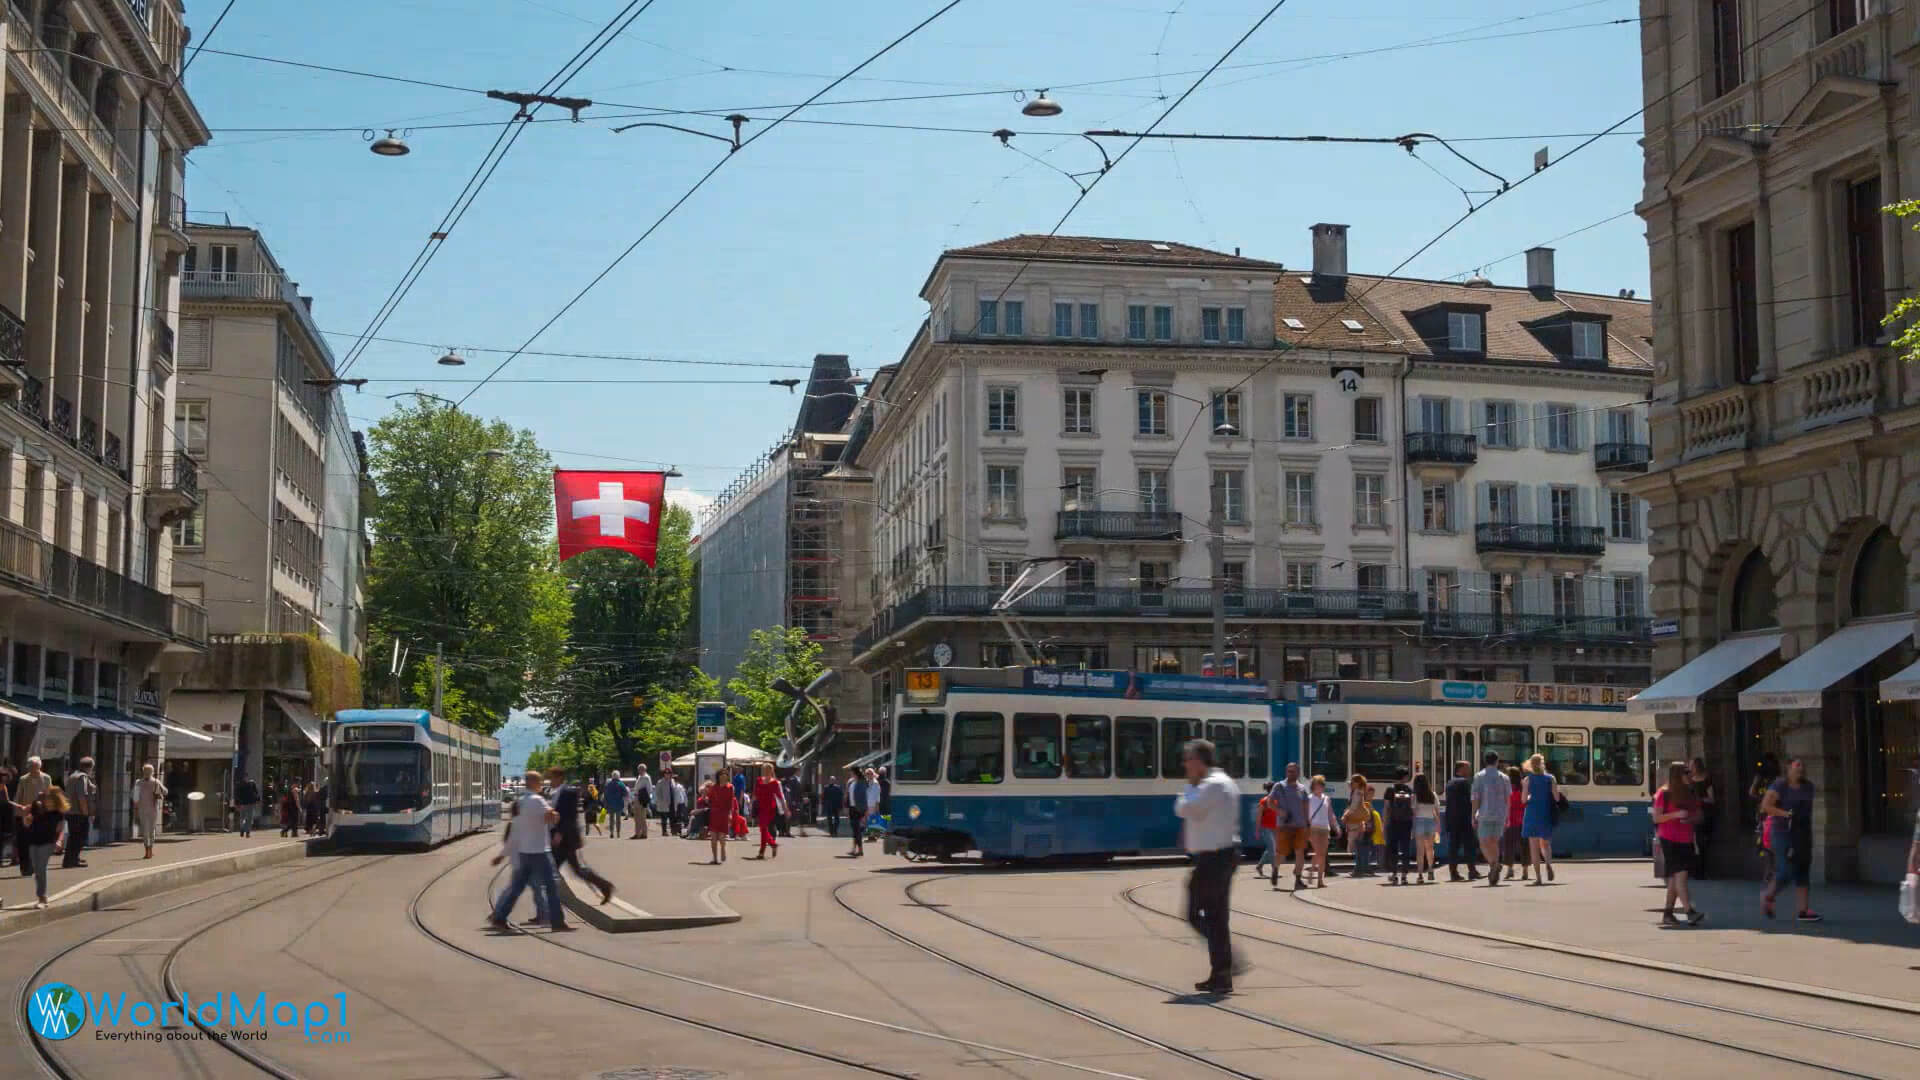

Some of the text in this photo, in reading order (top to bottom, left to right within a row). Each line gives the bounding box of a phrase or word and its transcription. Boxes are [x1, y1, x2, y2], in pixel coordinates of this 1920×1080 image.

[1338, 378, 1358, 392] 14
[915, 673, 933, 688] 13
[1327, 684, 1335, 700] 7
